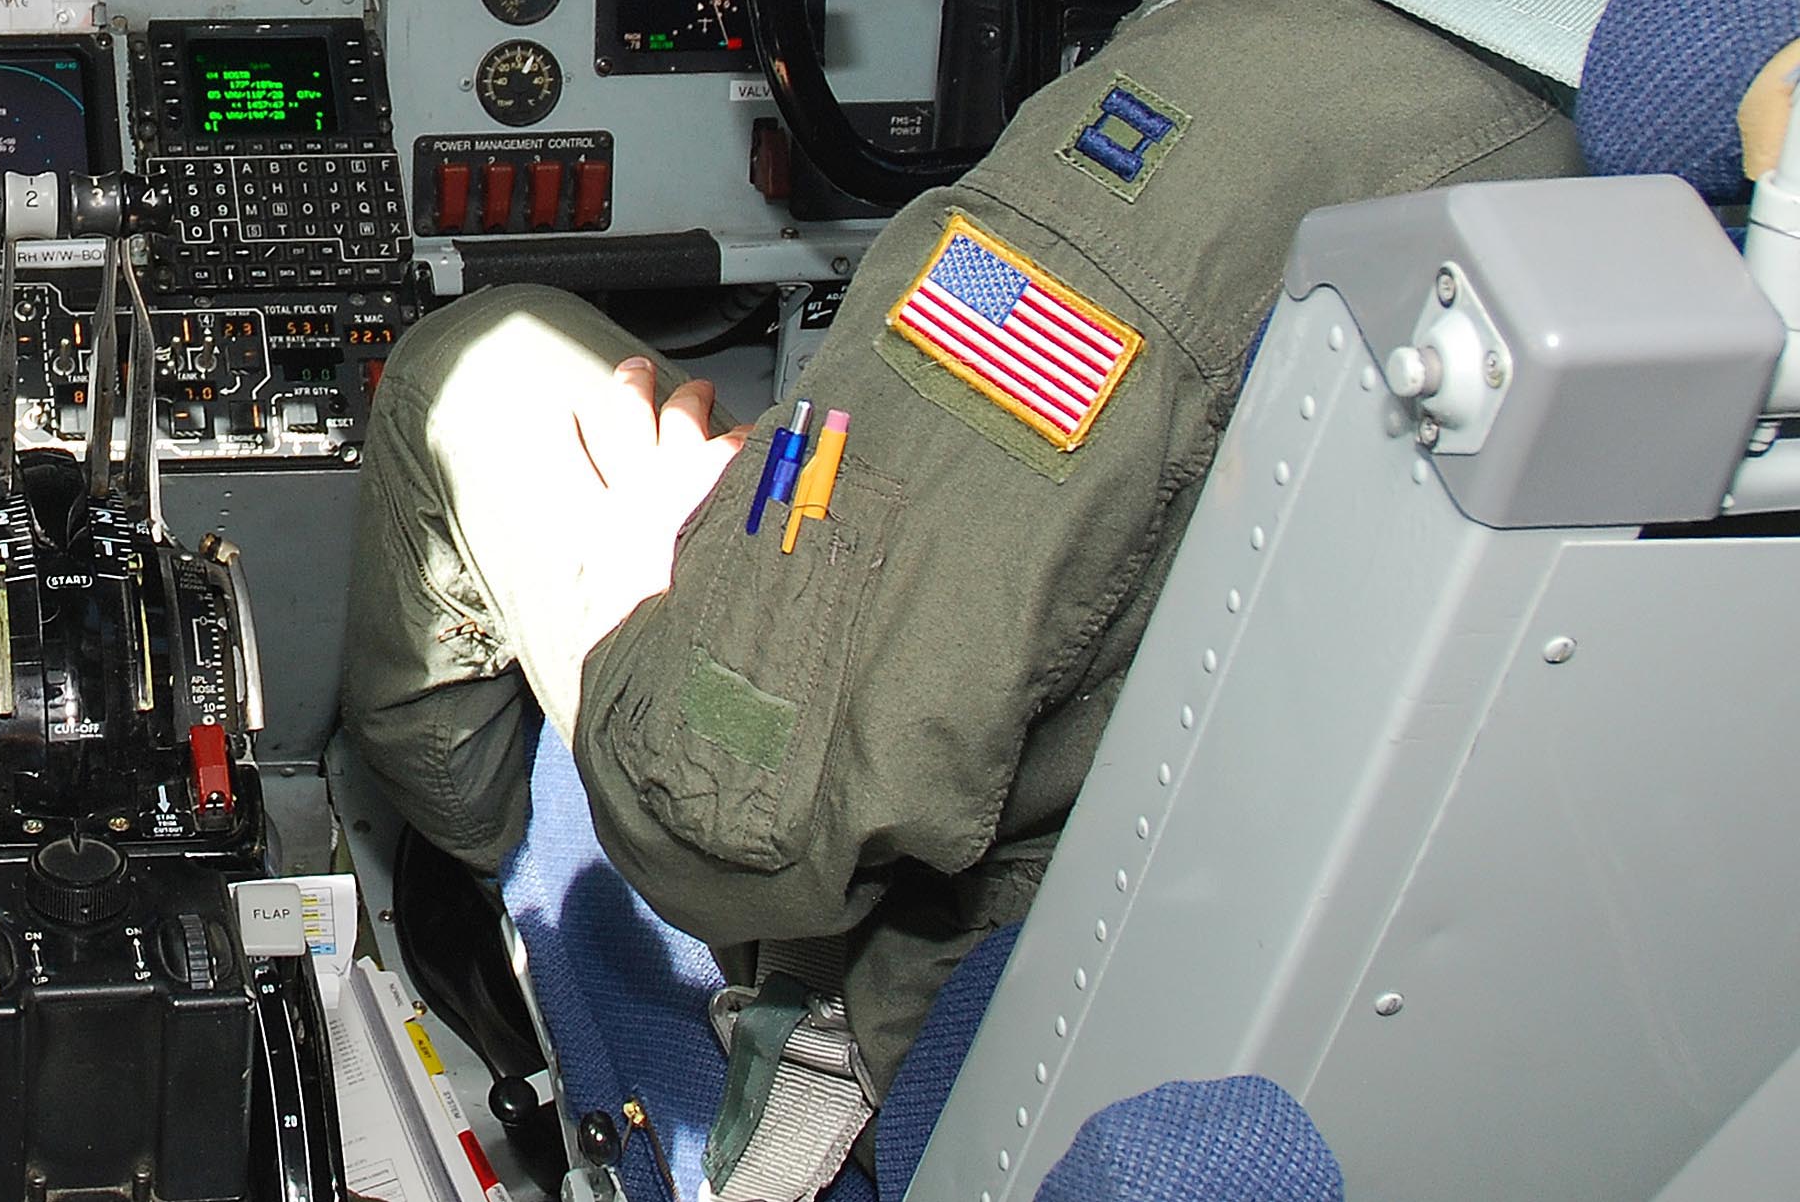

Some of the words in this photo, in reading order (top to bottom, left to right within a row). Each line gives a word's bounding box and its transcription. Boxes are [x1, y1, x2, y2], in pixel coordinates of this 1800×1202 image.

[738, 85, 771, 98] VALV
[890, 116, 922, 126] FMS-2
[890, 126, 922, 136] POWER
[434, 141, 471, 151] POWER
[475, 139, 544, 150] MANAGEMENT
[548, 138, 595, 149] CONTROL
[25, 190, 39, 208] 2
[17, 252, 38, 263] RH
[42, 249, 106, 262] W/W-BO
[264, 305, 291, 314] TOTAL
[293, 304, 316, 314] FUEL
[364, 314, 384, 323] MAC
[326, 418, 354, 427] RESET
[97, 511, 112, 524] 2
[50, 575, 89, 586] START
[191, 675, 208, 685] APL
[192, 684, 216, 694] NOSE
[193, 694, 205, 703] UP
[53, 723, 100, 735] CUT-OFF
[153, 825, 184, 835] CUTOUT
[253, 908, 291, 920] FLAP
[24, 931, 43, 941] DN
[125, 926, 142, 936] DN
[135, 970, 151, 980] UP
[417, 1039, 432, 1060] ALERT
[284, 1115, 298, 1128] 20
